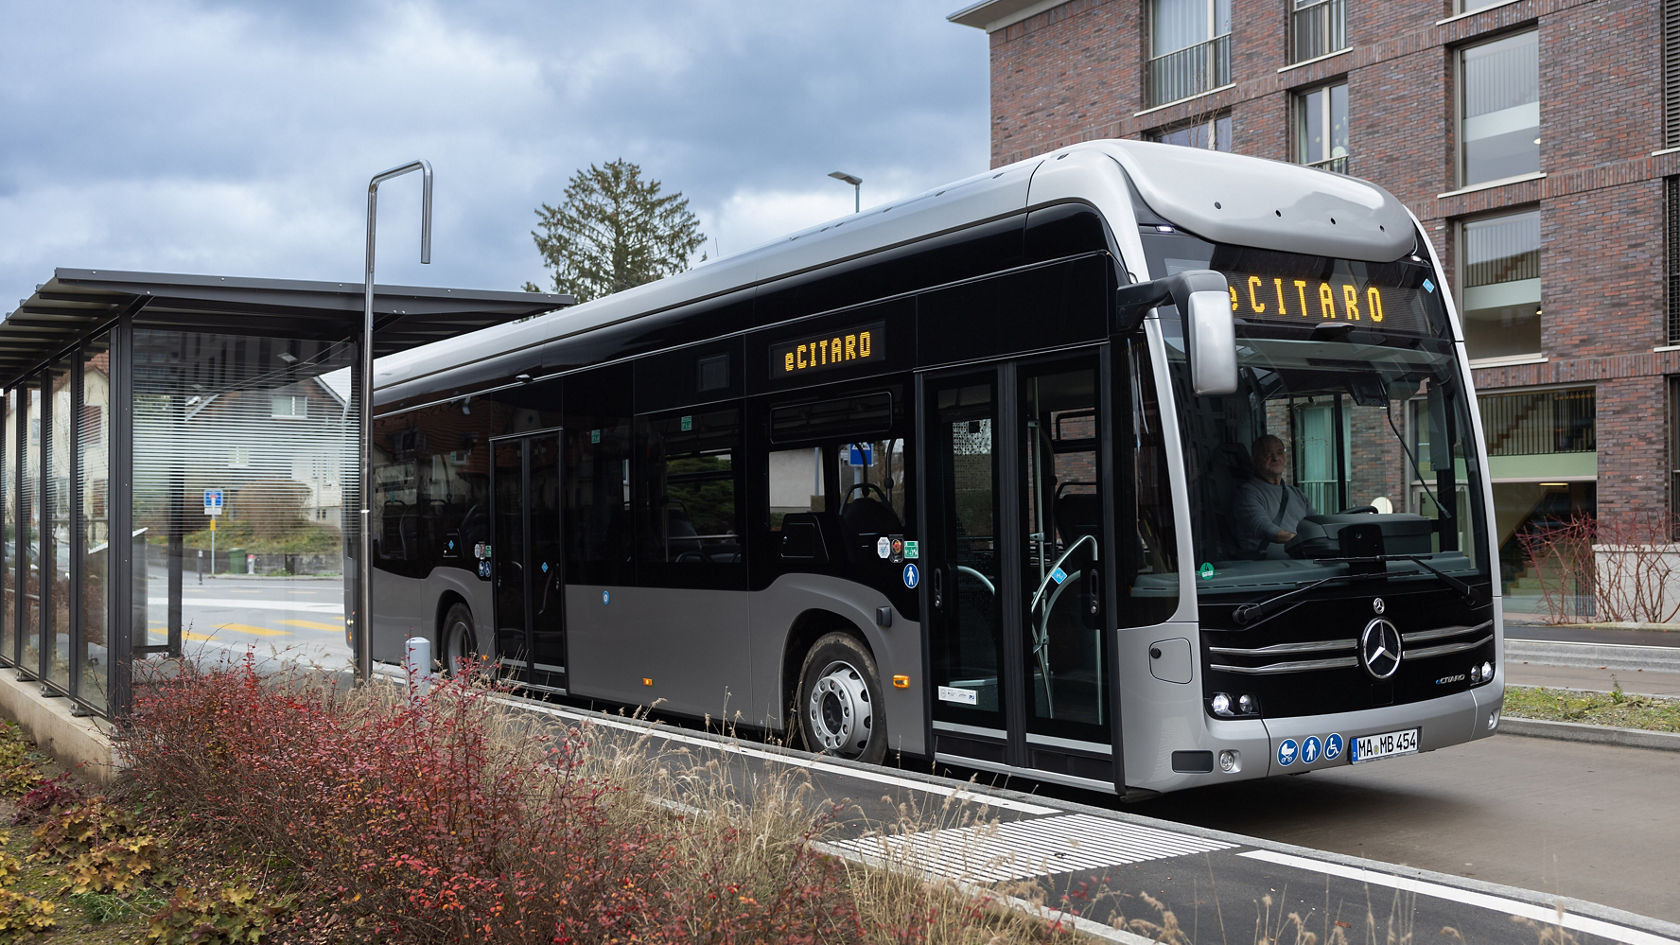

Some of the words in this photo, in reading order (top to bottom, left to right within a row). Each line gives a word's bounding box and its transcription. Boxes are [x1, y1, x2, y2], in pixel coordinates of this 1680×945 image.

[784, 331, 871, 372] eCITARO
[1358, 739, 1373, 757] MA
[1380, 736, 1394, 753] MB
[1396, 732, 1416, 750] 454
